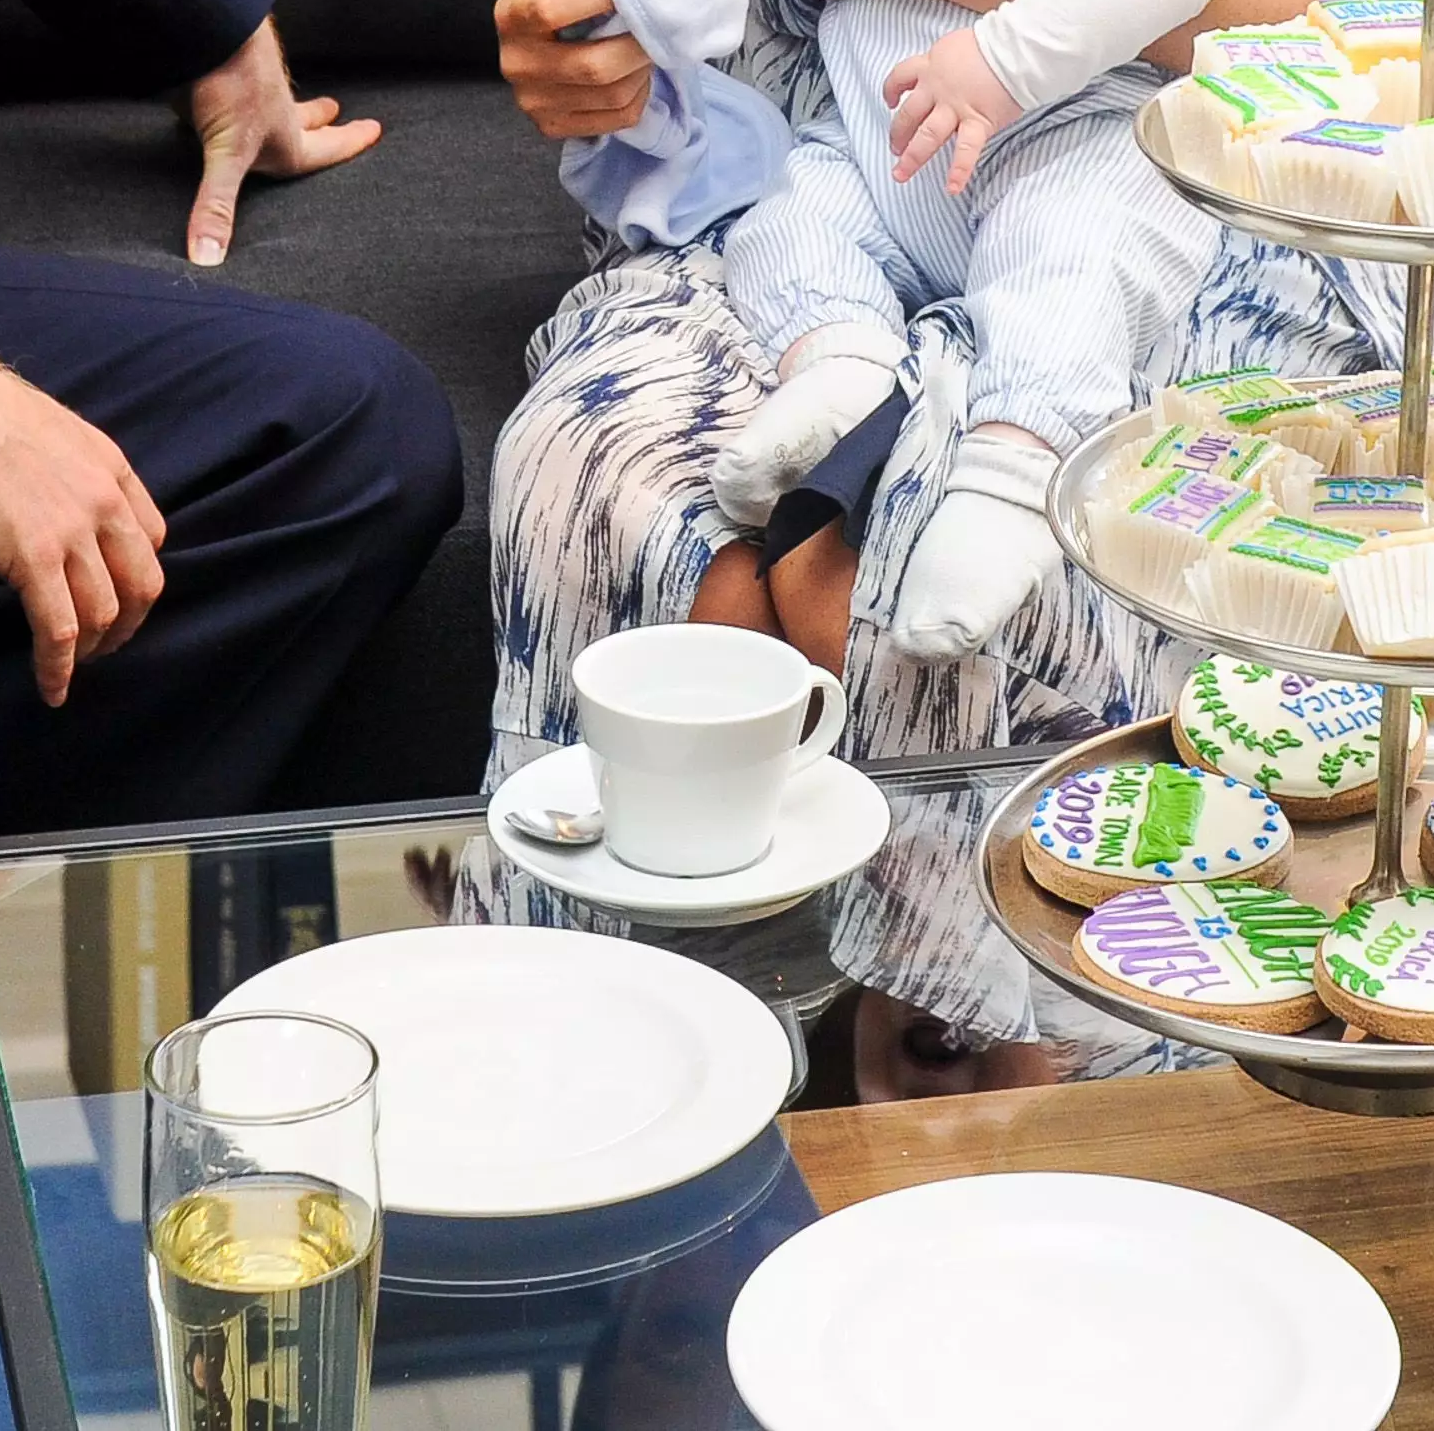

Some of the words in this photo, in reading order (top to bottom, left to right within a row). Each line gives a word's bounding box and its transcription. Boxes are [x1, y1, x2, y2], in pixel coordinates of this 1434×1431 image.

[1223, 43, 1327, 63] FAITH
[1204, 377, 1292, 405] LOVE
[1172, 431, 1238, 473] LOVE
[1150, 477, 1237, 529] PEACE
[1328, 482, 1407, 501] JOY
[1306, 704, 1383, 742] OUTH
[1104, 764, 1148, 809] CAPE
[1052, 775, 1103, 845] 2019
[1093, 815, 1133, 867] TOWN
[1085, 885, 1231, 997] ENOUGH
[1204, 879, 1336, 983] ENOUGH
[1364, 920, 1417, 967] 2019
